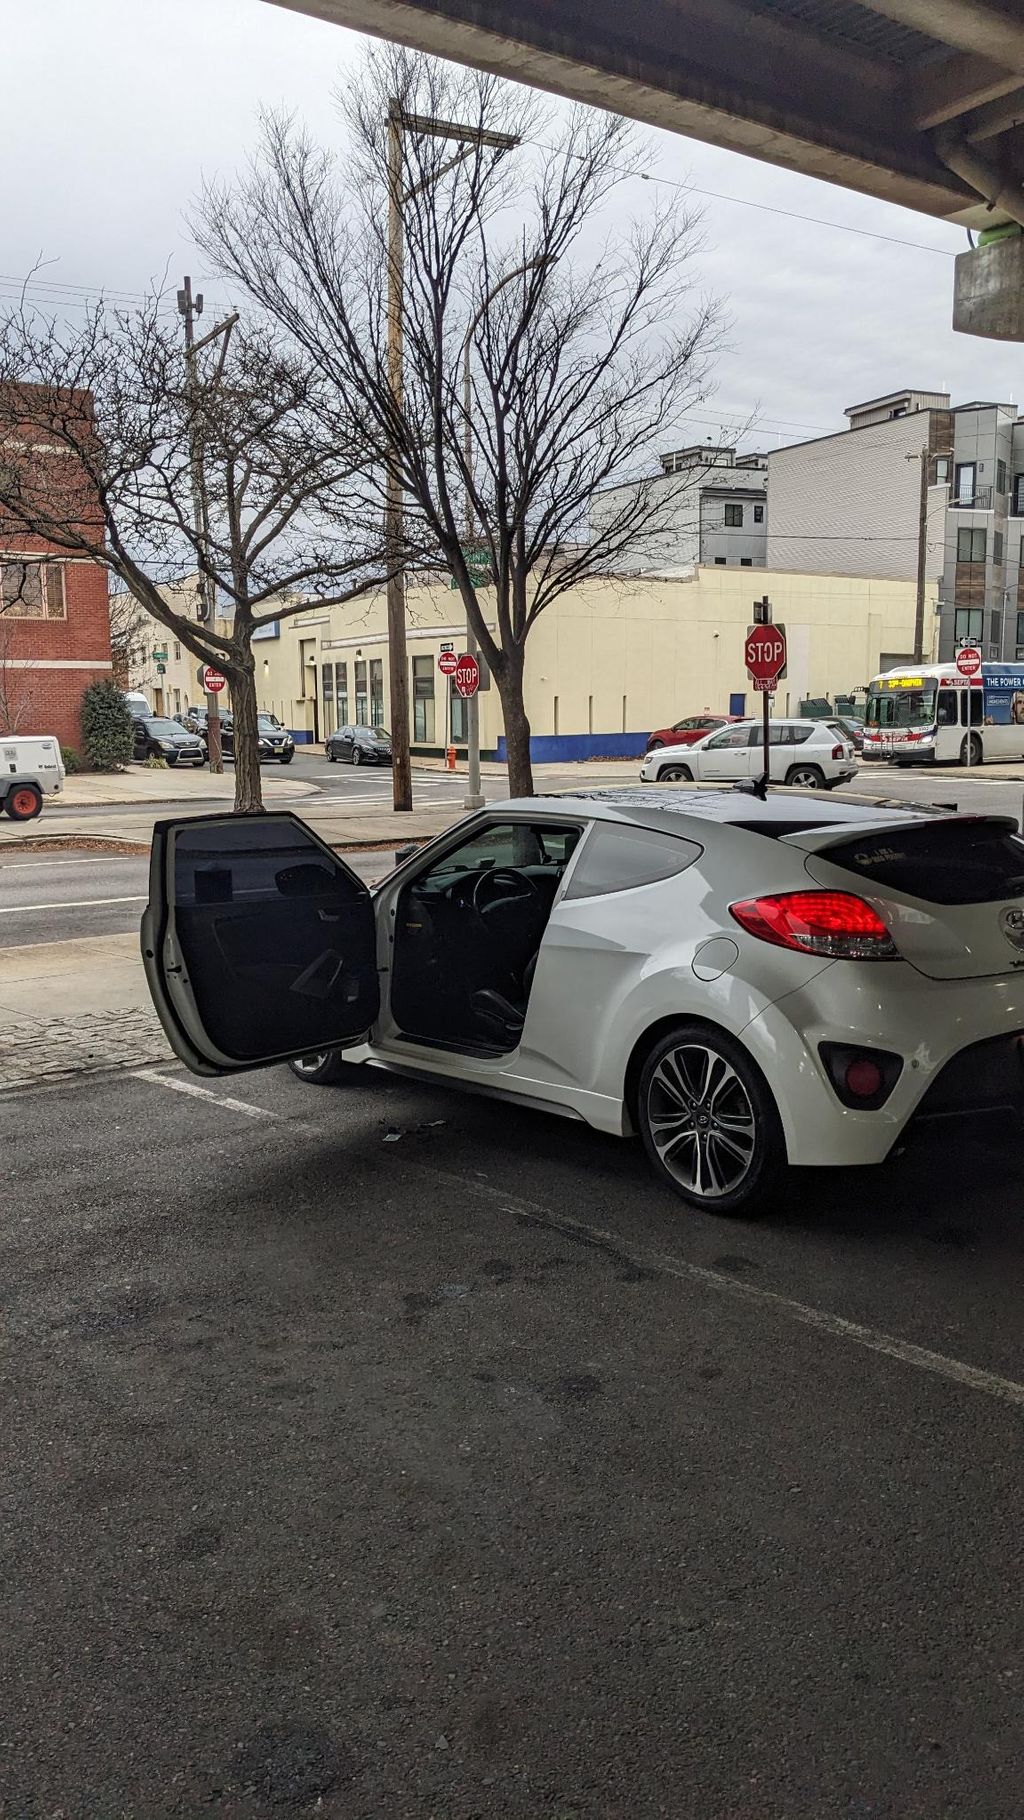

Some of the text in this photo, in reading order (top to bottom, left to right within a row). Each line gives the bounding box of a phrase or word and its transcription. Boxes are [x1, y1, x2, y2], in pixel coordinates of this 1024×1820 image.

[747, 642, 783, 663] STOP
[457, 667, 477, 684] STOP
[986, 677, 1000, 687] THE
[1000, 677, 1022, 687] POWER
